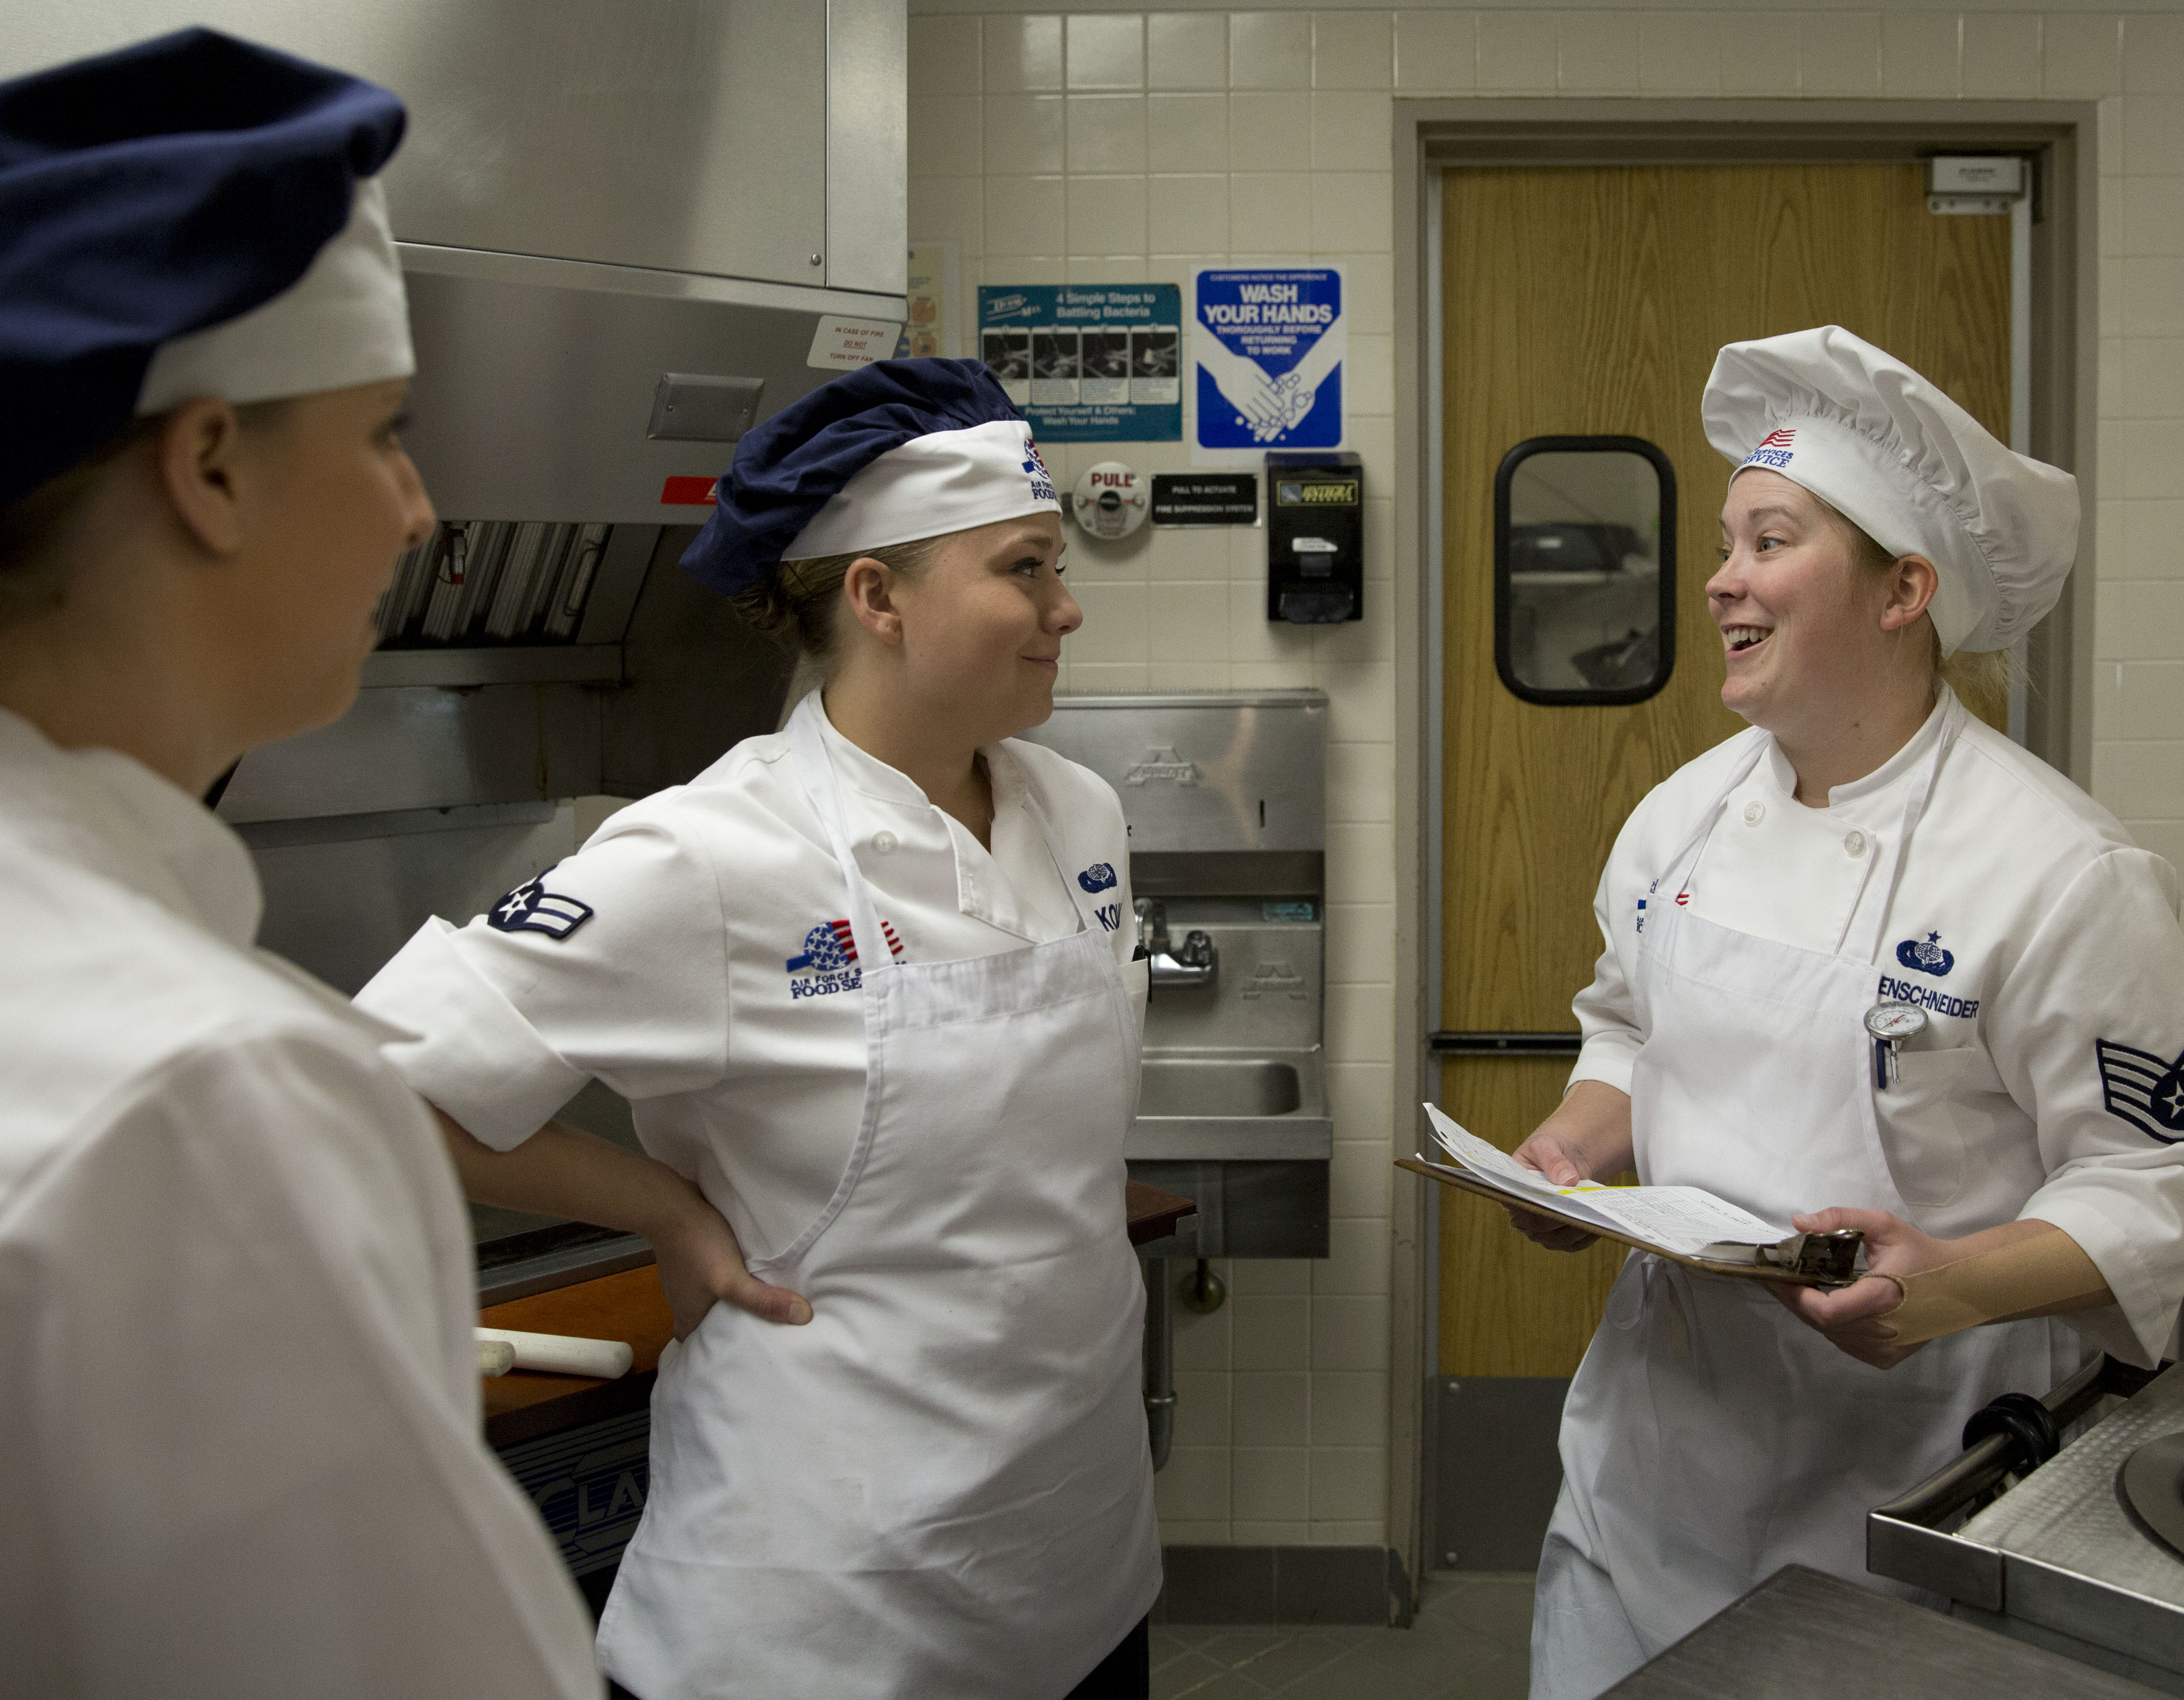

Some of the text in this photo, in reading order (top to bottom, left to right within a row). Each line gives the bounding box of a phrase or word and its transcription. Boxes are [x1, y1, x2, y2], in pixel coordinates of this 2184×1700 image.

[1240, 284, 1298, 303] WASH
[1056, 292, 1156, 306] 4 Simple Steps to
[1057, 306, 1101, 320] Battling
[1103, 305, 1150, 318] Bacteria
[1204, 304, 1333, 324] YOUR HANDS
[1216, 325, 1322, 334] THOROUGHLY BEFORE
[1241, 335, 1297, 345] RETURNING
[1246, 346, 1292, 355] TO WORK
[1024, 407, 1057, 415] Protect
[1059, 407, 1093, 415] Yourself
[1095, 407, 1102, 415] &
[1042, 416, 1119, 425] Wash Your Hands
[1091, 473, 1133, 488] PULL
[1171, 486, 1191, 494] PULL
[1192, 485, 1203, 494] TO
[1155, 505, 1172, 514] FIRE
[791, 978, 810, 988] AIR
[791, 982, 839, 999] FOOD
